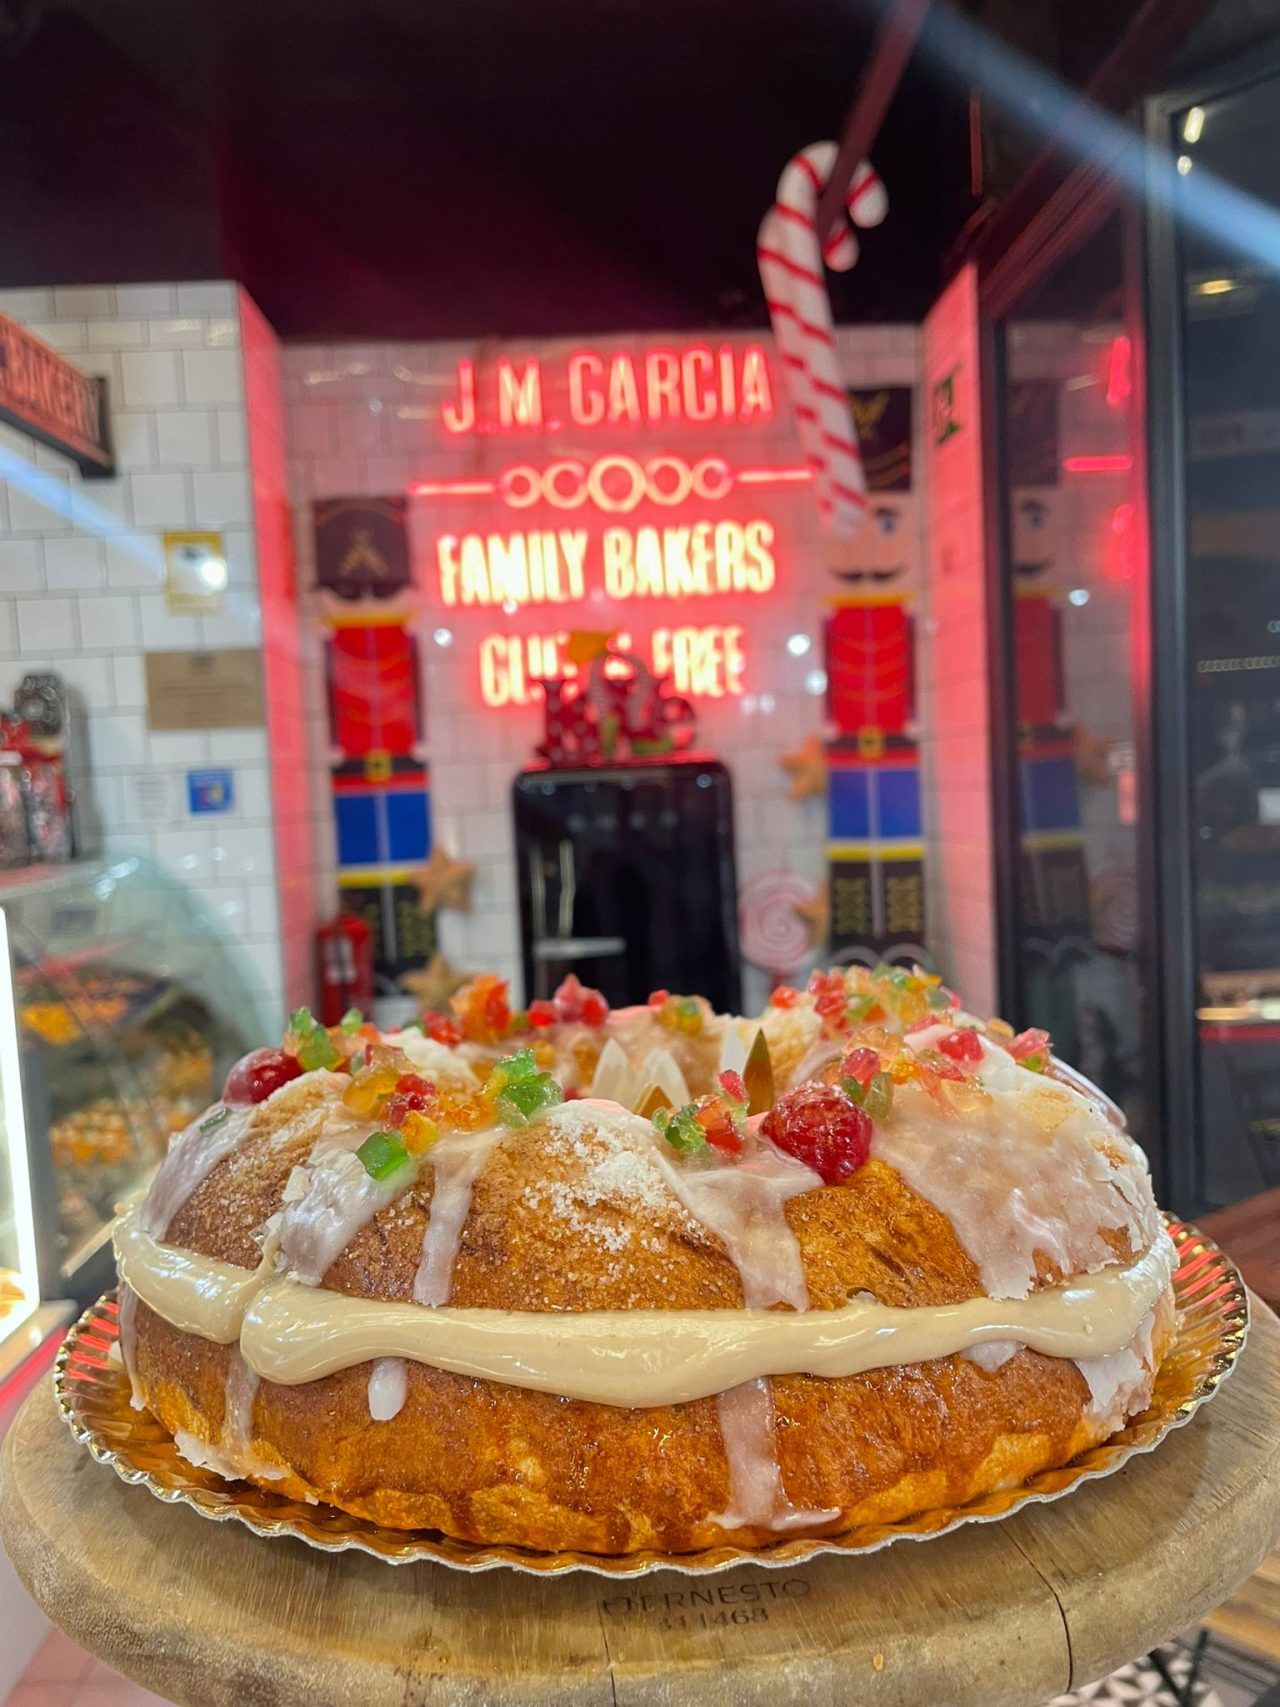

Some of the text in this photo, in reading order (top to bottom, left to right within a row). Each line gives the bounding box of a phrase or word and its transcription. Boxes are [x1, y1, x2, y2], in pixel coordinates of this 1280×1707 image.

[567, 347, 774, 425] GARCIA
[437, 520, 776, 606] FAMILY BAKERS
[651, 625, 745, 697] FREE
